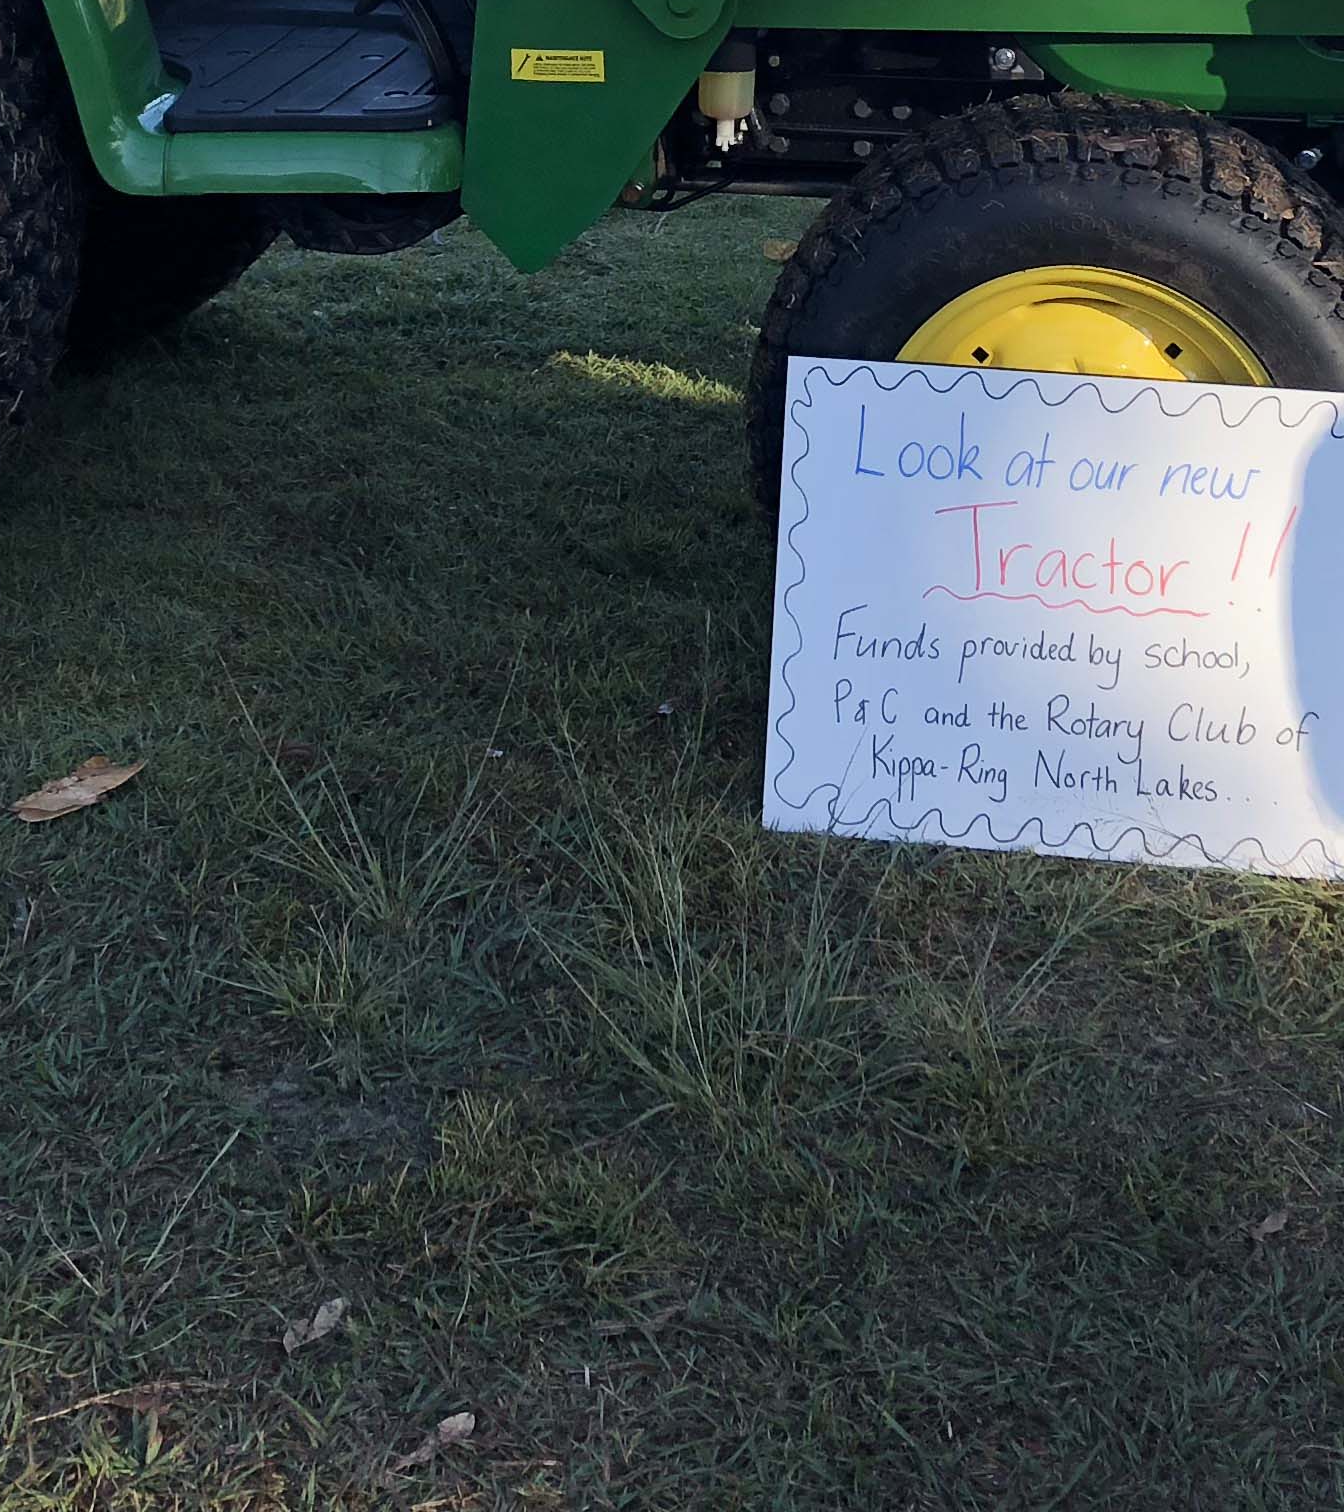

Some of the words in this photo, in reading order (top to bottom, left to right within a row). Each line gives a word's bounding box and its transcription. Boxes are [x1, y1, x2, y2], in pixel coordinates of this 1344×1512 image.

[856, 404, 984, 480] Look
[1005, 432, 1056, 488] at
[1069, 457, 1139, 491] our
[1159, 462, 1262, 500] new
[935, 500, 1191, 596] Tractor
[833, 603, 940, 662] Funds
[957, 629, 1077, 684] provided
[1088, 633, 1123, 691] by
[1144, 637, 1251, 679] school,
[871, 733, 1009, 804] Kippa-Ring
[1034, 749, 1119, 795] North
[924, 698, 972, 729] and
[987, 701, 1030, 733] the
[1047, 694, 1146, 765] Rotary
[1168, 702, 1257, 747] Club
[1276, 711, 1320, 754] of
